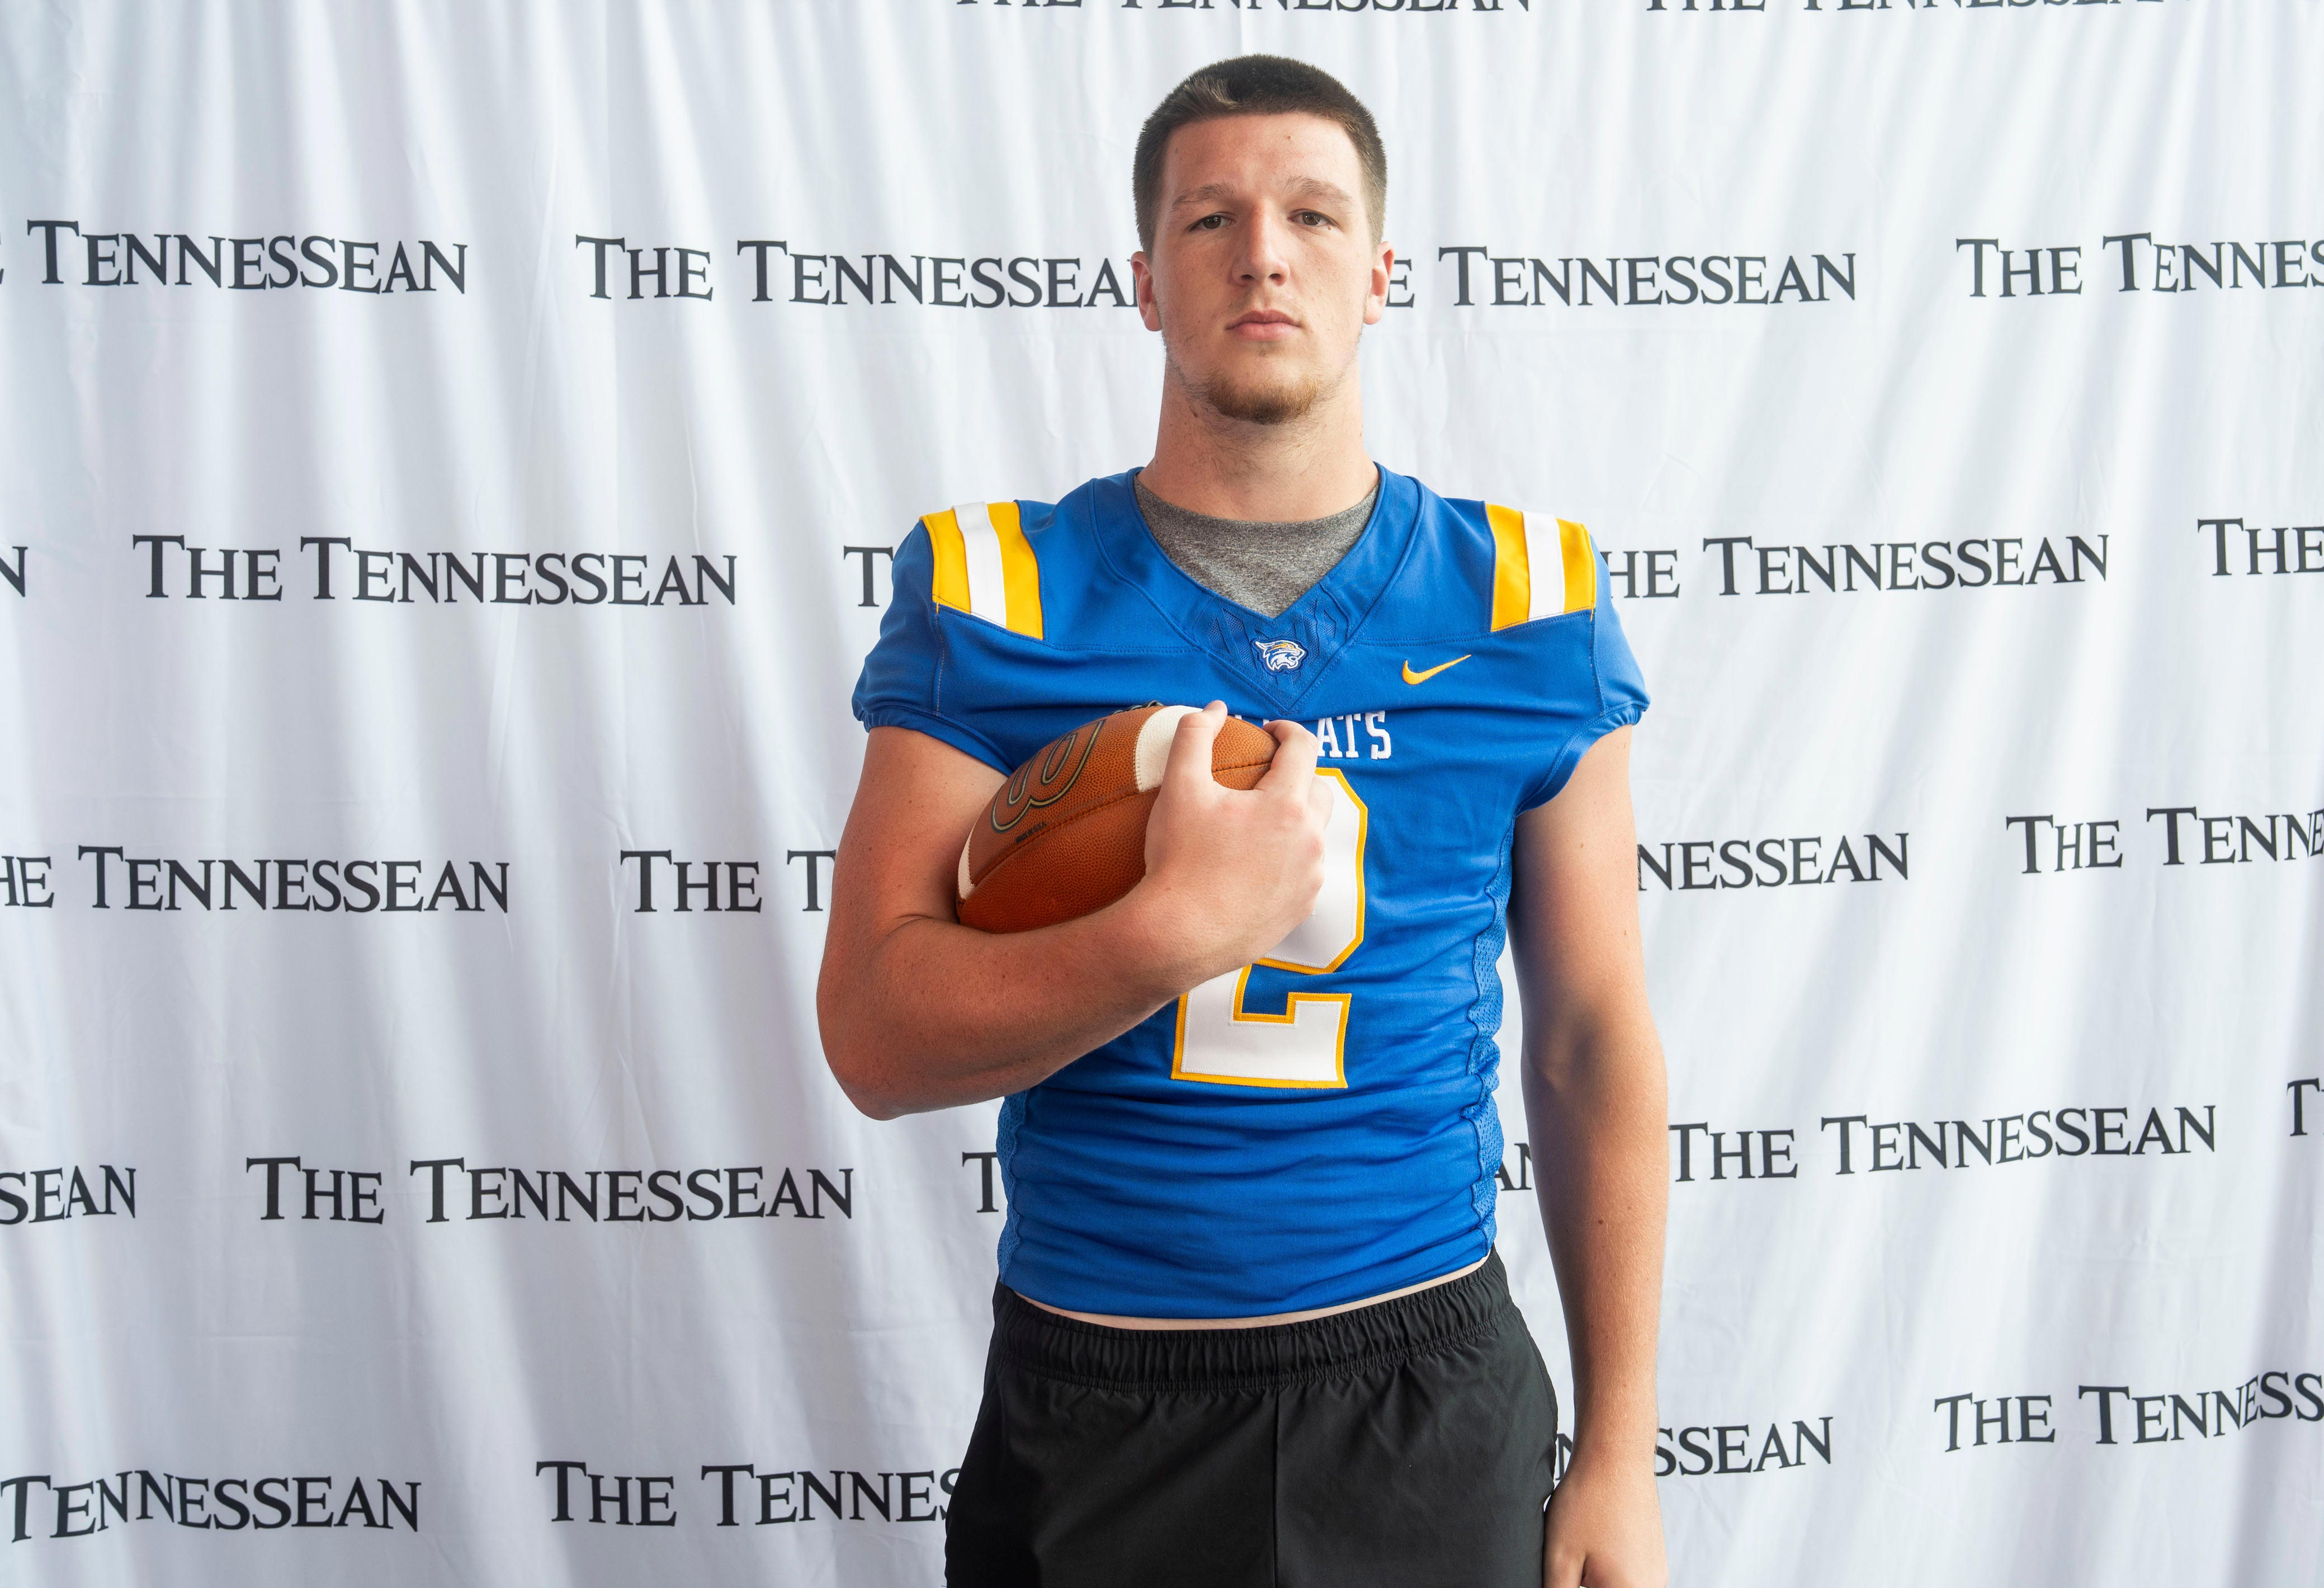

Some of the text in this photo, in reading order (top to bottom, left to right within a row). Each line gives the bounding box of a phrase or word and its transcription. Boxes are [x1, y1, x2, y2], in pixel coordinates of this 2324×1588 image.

[27, 219, 468, 295] TENNESSEAN
[576, 234, 1138, 309] THE TENNESSEA
[1438, 246, 1857, 307] TENNESSEAN
[1956, 232, 2324, 298] THE TENNE
[133, 535, 738, 607] THE TENNESSEAN
[1600, 535, 2109, 599] HE TENNESSEAN
[2197, 517, 2324, 576] THE
[1637, 832, 1910, 892] NESSEAN
[2006, 806, 2324, 874] THE TENNE
[78, 845, 511, 914] TENNESSEAN
[620, 850, 763, 914] THE
[1668, 1122, 1798, 1182] THE
[1821, 1105, 2216, 1176] TENNESSEAN
[246, 1156, 855, 1226] THE TENNESSEAN
[1934, 1371, 2324, 1453] THE TENNESS
[1555, 1416, 1834, 1481] SSEAN
[0, 1469, 422, 1544] TENNESSEAN
[536, 1460, 678, 1528] THE
